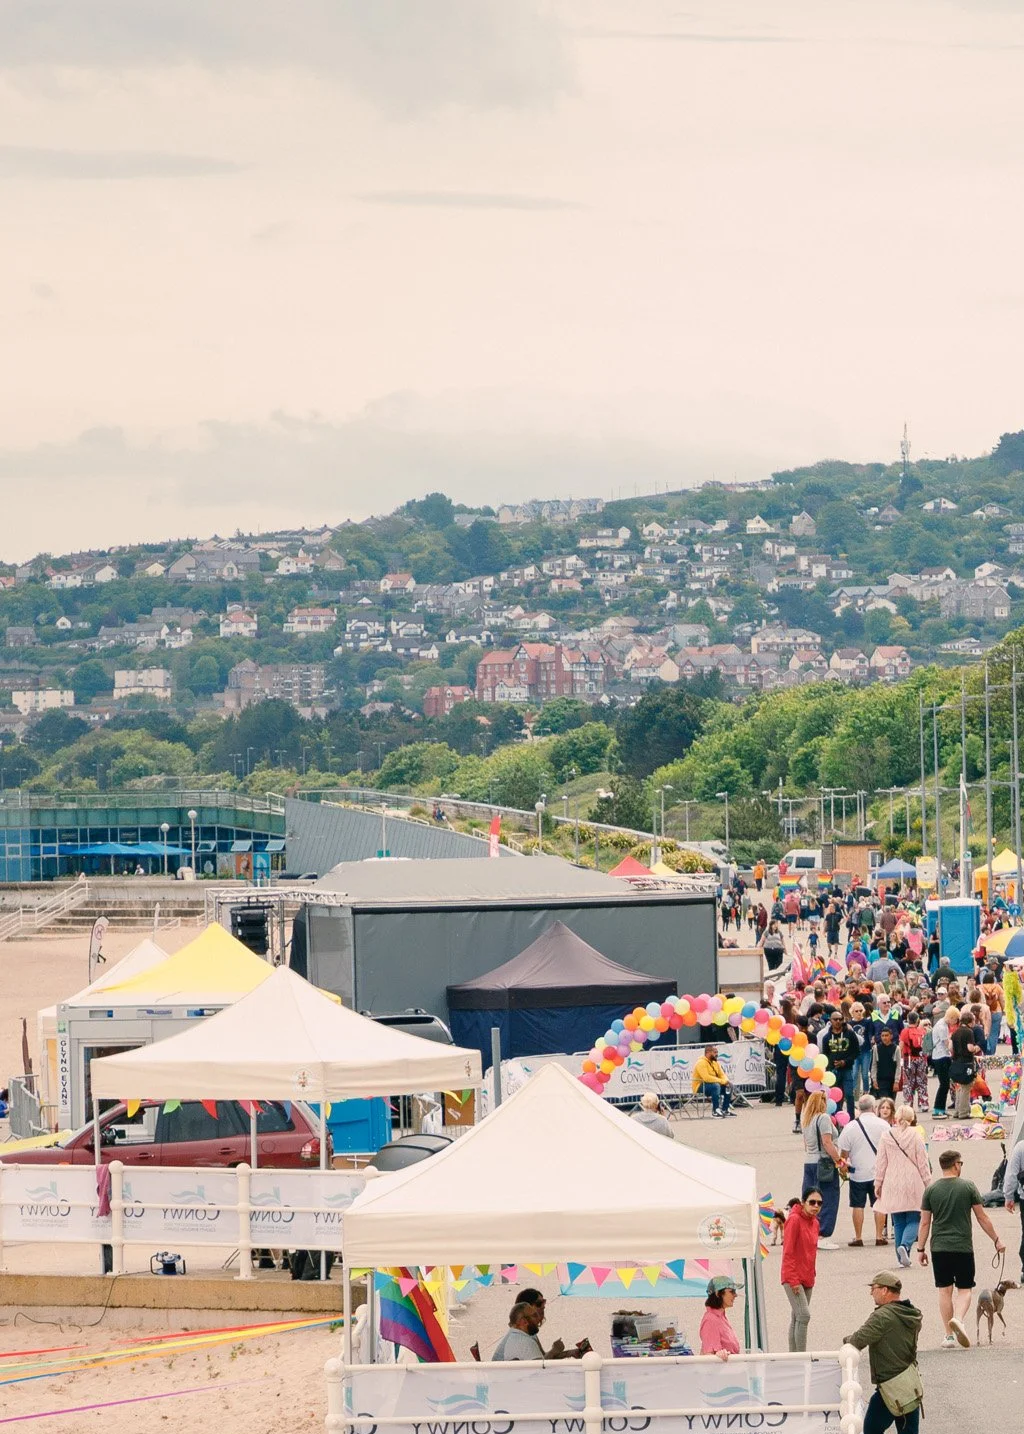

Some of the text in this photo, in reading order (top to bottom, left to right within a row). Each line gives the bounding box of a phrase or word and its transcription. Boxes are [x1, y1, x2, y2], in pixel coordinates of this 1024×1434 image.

[60, 1041, 69, 1064] GLYN
[620, 1070, 651, 1084] CONWY
[665, 1068, 692, 1081] CONW
